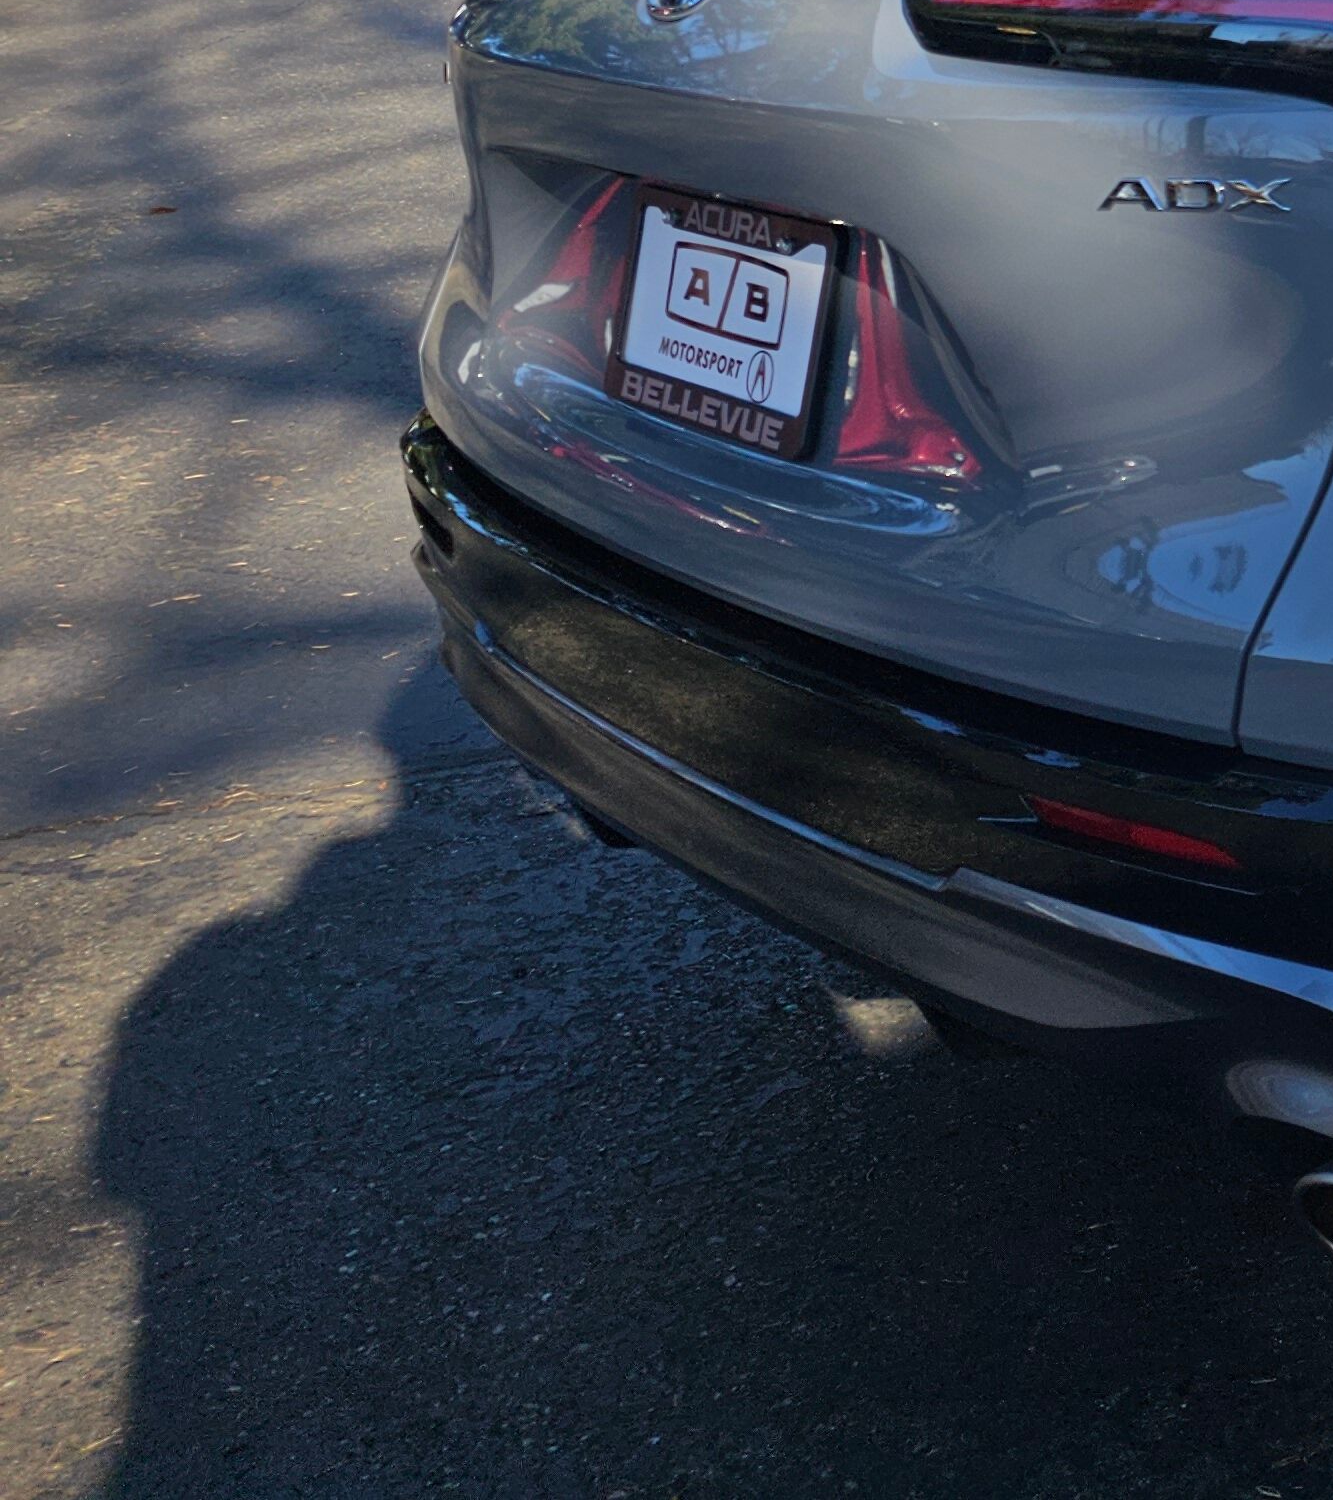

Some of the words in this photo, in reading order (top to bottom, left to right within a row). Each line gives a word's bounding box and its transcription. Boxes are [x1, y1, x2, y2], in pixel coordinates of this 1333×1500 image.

[1097, 177, 1292, 212] ADX
[683, 202, 772, 247] ACURA
[684, 268, 710, 306] A
[743, 282, 769, 323] B
[659, 336, 743, 379] MOTORSPORT
[620, 369, 784, 450] BELLEVUE
